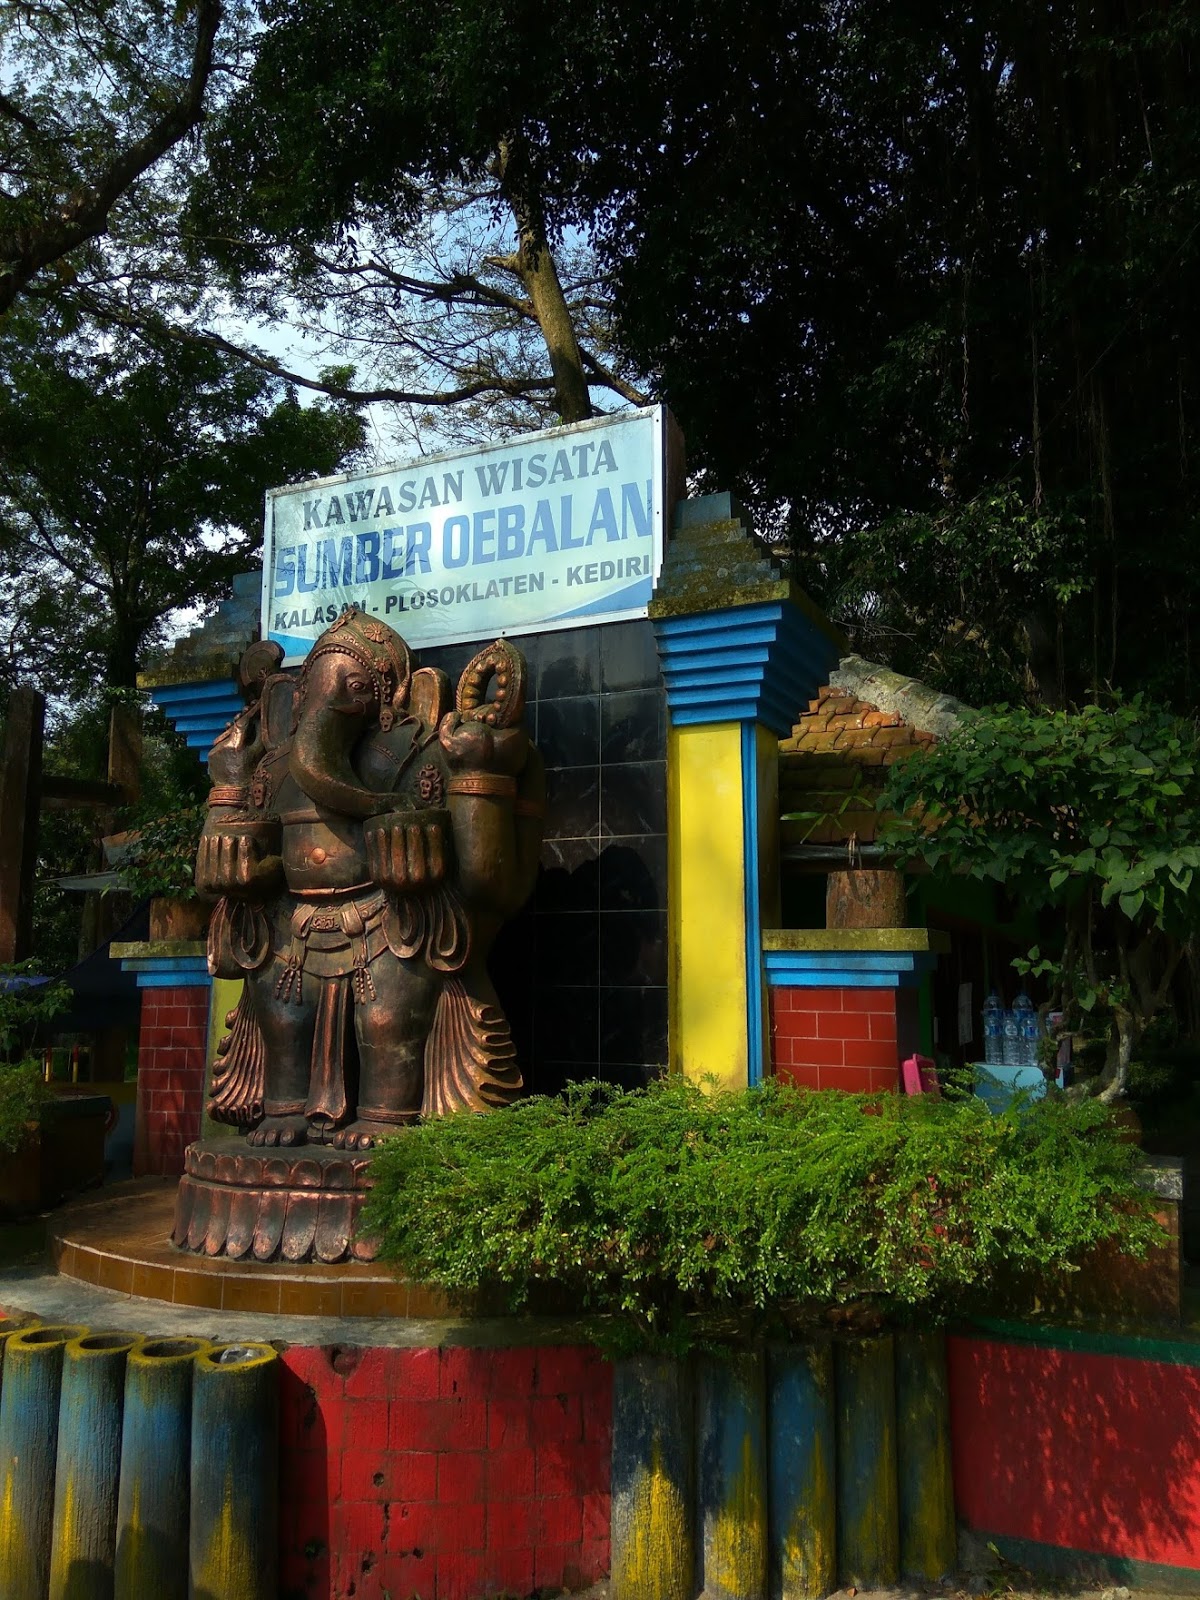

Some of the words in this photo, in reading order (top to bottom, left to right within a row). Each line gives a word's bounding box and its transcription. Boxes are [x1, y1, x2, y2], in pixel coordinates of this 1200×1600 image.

[302, 469, 465, 531] KAWASAN
[474, 440, 619, 498] WISATA
[275, 522, 432, 597] SUMBER
[442, 479, 652, 569] OEBALAN
[385, 572, 545, 614] PLOSOKLATEN
[566, 555, 650, 587] KEDIRI
